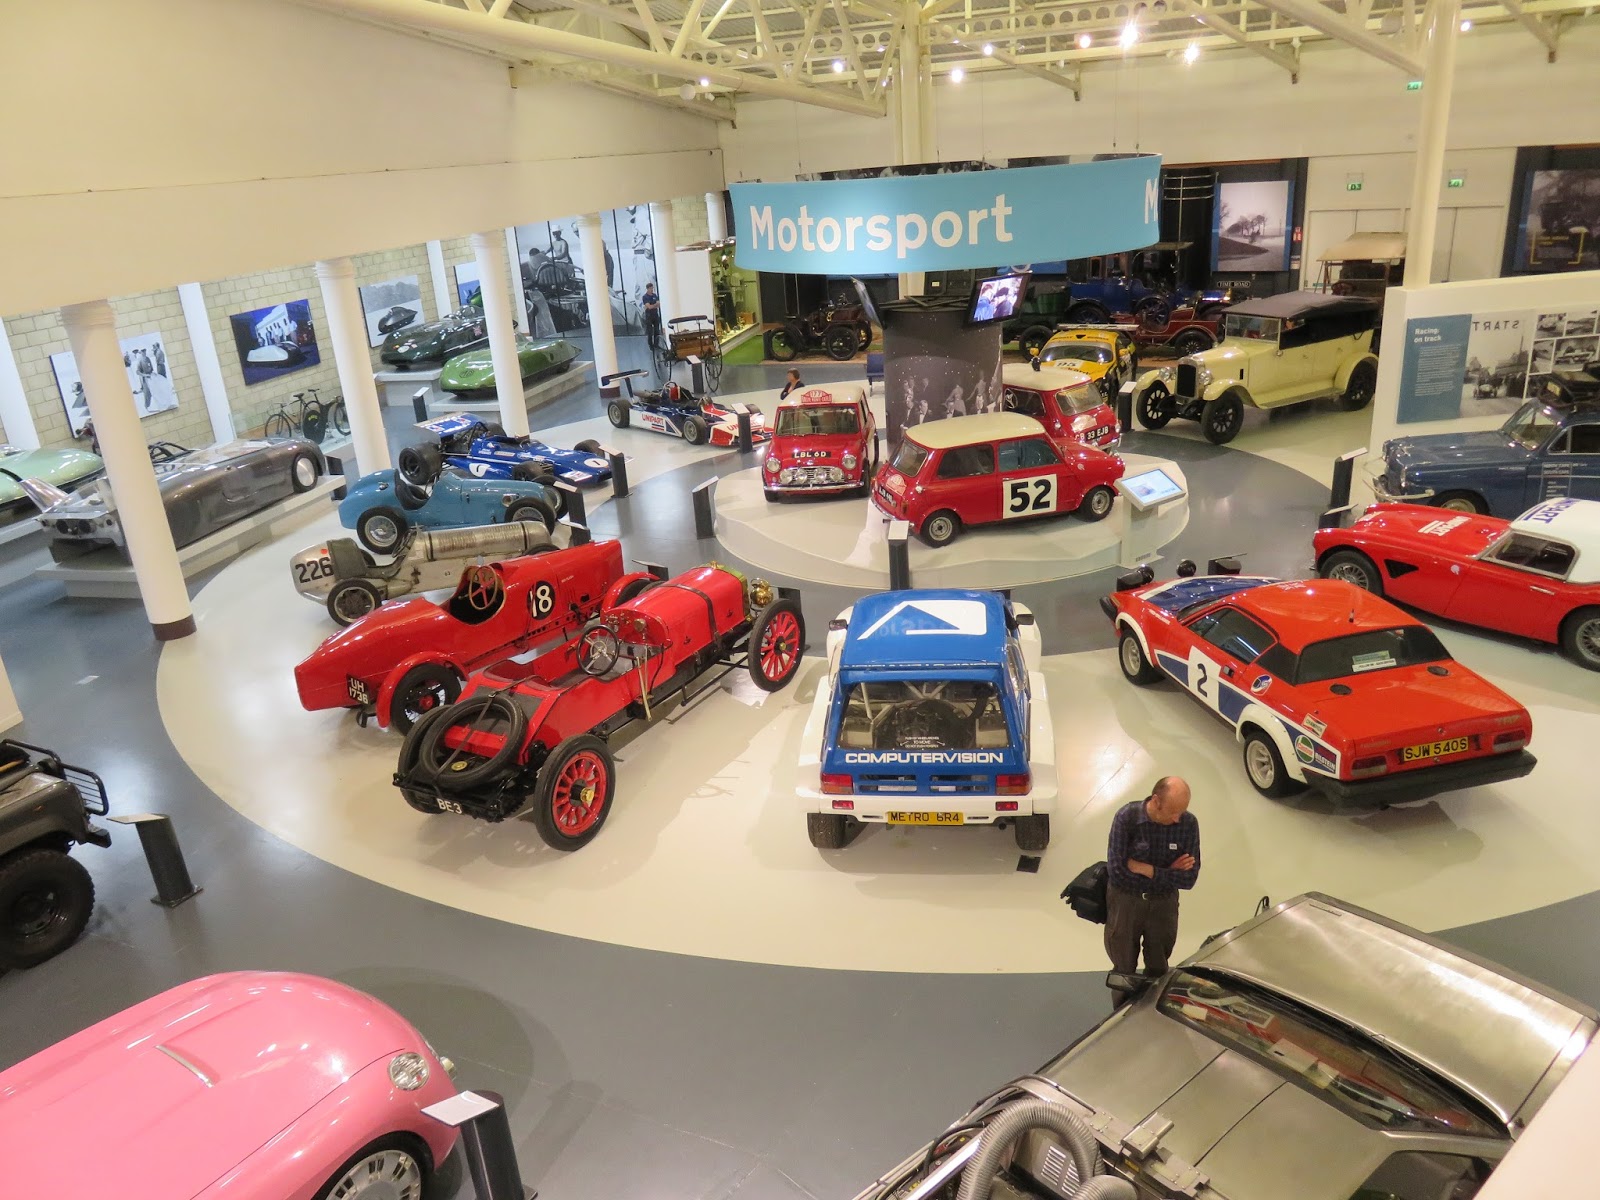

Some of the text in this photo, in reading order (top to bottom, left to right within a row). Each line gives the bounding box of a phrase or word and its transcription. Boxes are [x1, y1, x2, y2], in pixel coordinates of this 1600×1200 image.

[749, 193, 1013, 259] Motorsport
[1424, 335, 1442, 343] track
[641, 413, 664, 425] UNIPART
[1087, 431, 1095, 440] 33
[1097, 426, 1109, 437] EJB
[1009, 478, 1052, 513] 52
[294, 556, 335, 584] 226
[529, 584, 553, 618] 18
[350, 677, 365, 693] UH
[1196, 662, 1208, 698] 2
[845, 752, 1004, 764] COMPUTERVISION
[1405, 738, 1467, 760] SJW 540S
[890, 812, 960, 823] METRO 6R4
